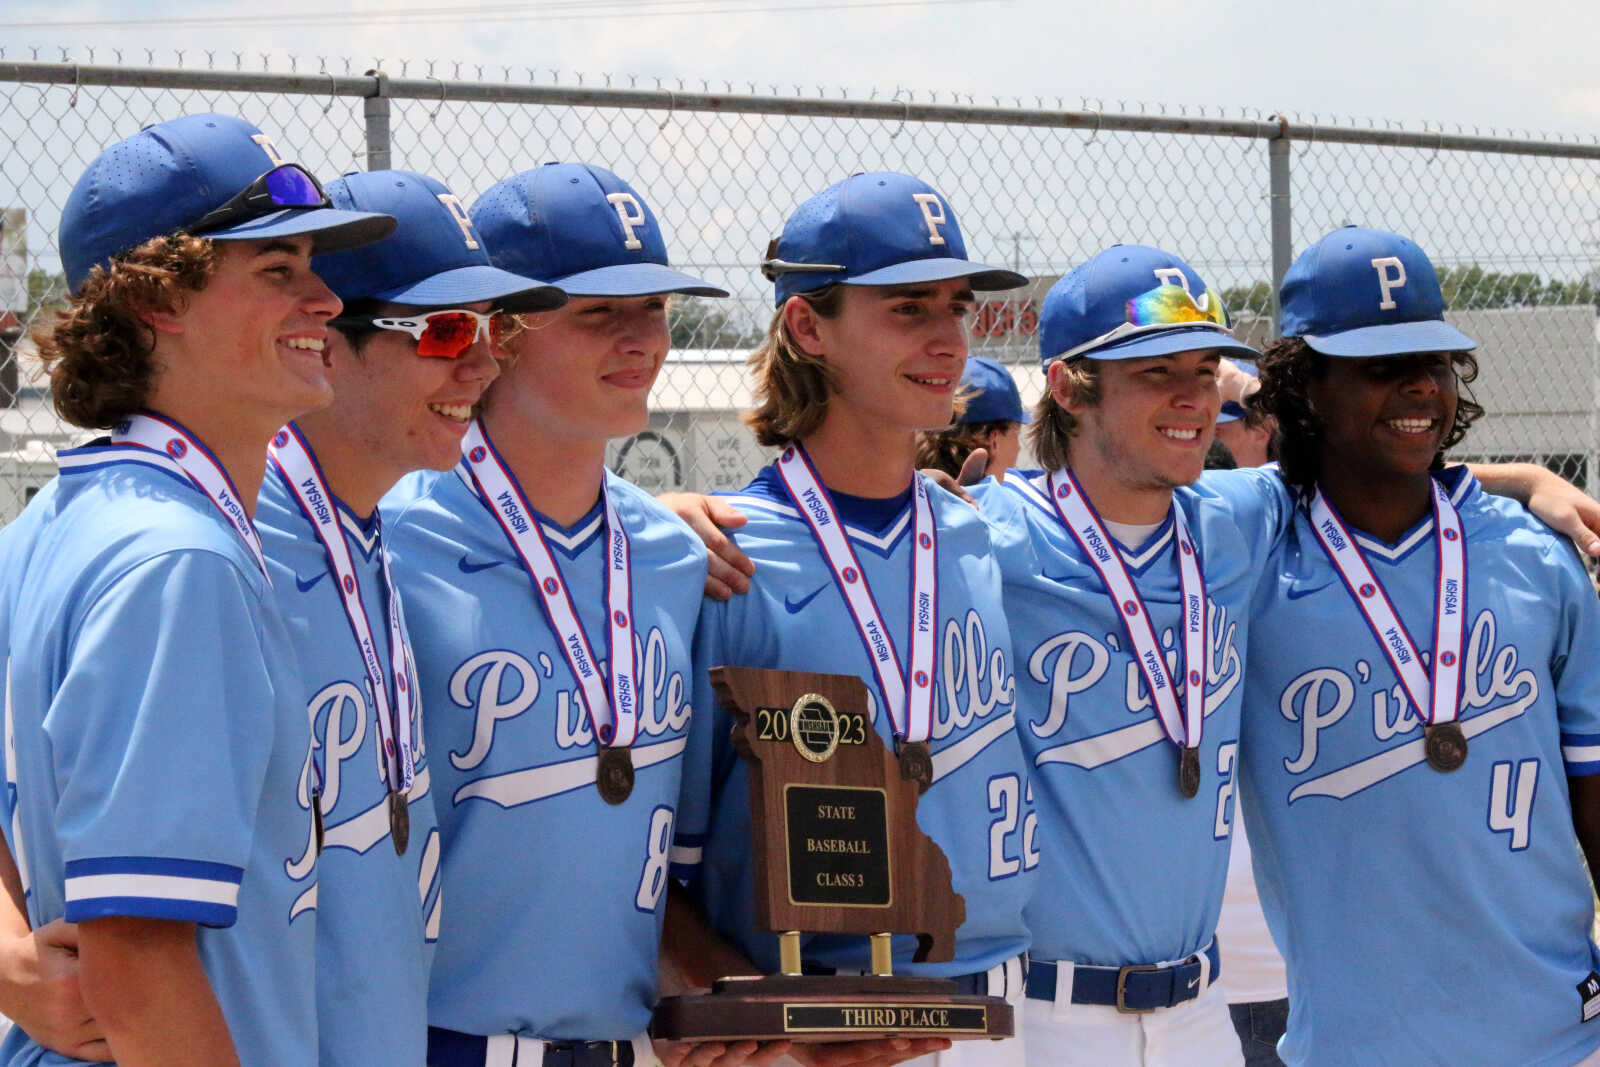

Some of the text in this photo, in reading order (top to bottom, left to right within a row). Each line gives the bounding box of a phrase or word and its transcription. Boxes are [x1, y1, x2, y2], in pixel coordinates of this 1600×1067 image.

[606, 192, 646, 250] P
[912, 193, 946, 246] P
[1370, 256, 1407, 310] P
[218, 488, 249, 536] MSHSAA
[302, 478, 331, 525] MSHSAA
[497, 490, 530, 534] MSHSAA
[802, 487, 831, 526] MSHSAA
[613, 529, 625, 571] MSHSAA
[1083, 525, 1112, 562] MSHSAA
[1324, 518, 1348, 553] MSHSAA
[918, 591, 929, 632] MSHSAA
[1188, 594, 1200, 633] MSHSAA
[1445, 578, 1457, 616] MSHSAA
[363, 638, 382, 685] MSHSAA
[568, 633, 593, 678] MSHSAA
[866, 620, 890, 662] MSHSAA
[1385, 627, 1411, 665] MSHSAA
[1143, 649, 1166, 690] MSHSAA
[617, 673, 633, 713] MSHSAA
[758, 709, 866, 745] 20 23
[818, 805, 856, 819] STATE
[1487, 758, 1541, 852] 4
[635, 804, 675, 914] 8
[807, 839, 871, 854] BASEBALL
[816, 873, 864, 887] CLASS 3
[842, 1009, 950, 1027] THIRD PLACE
